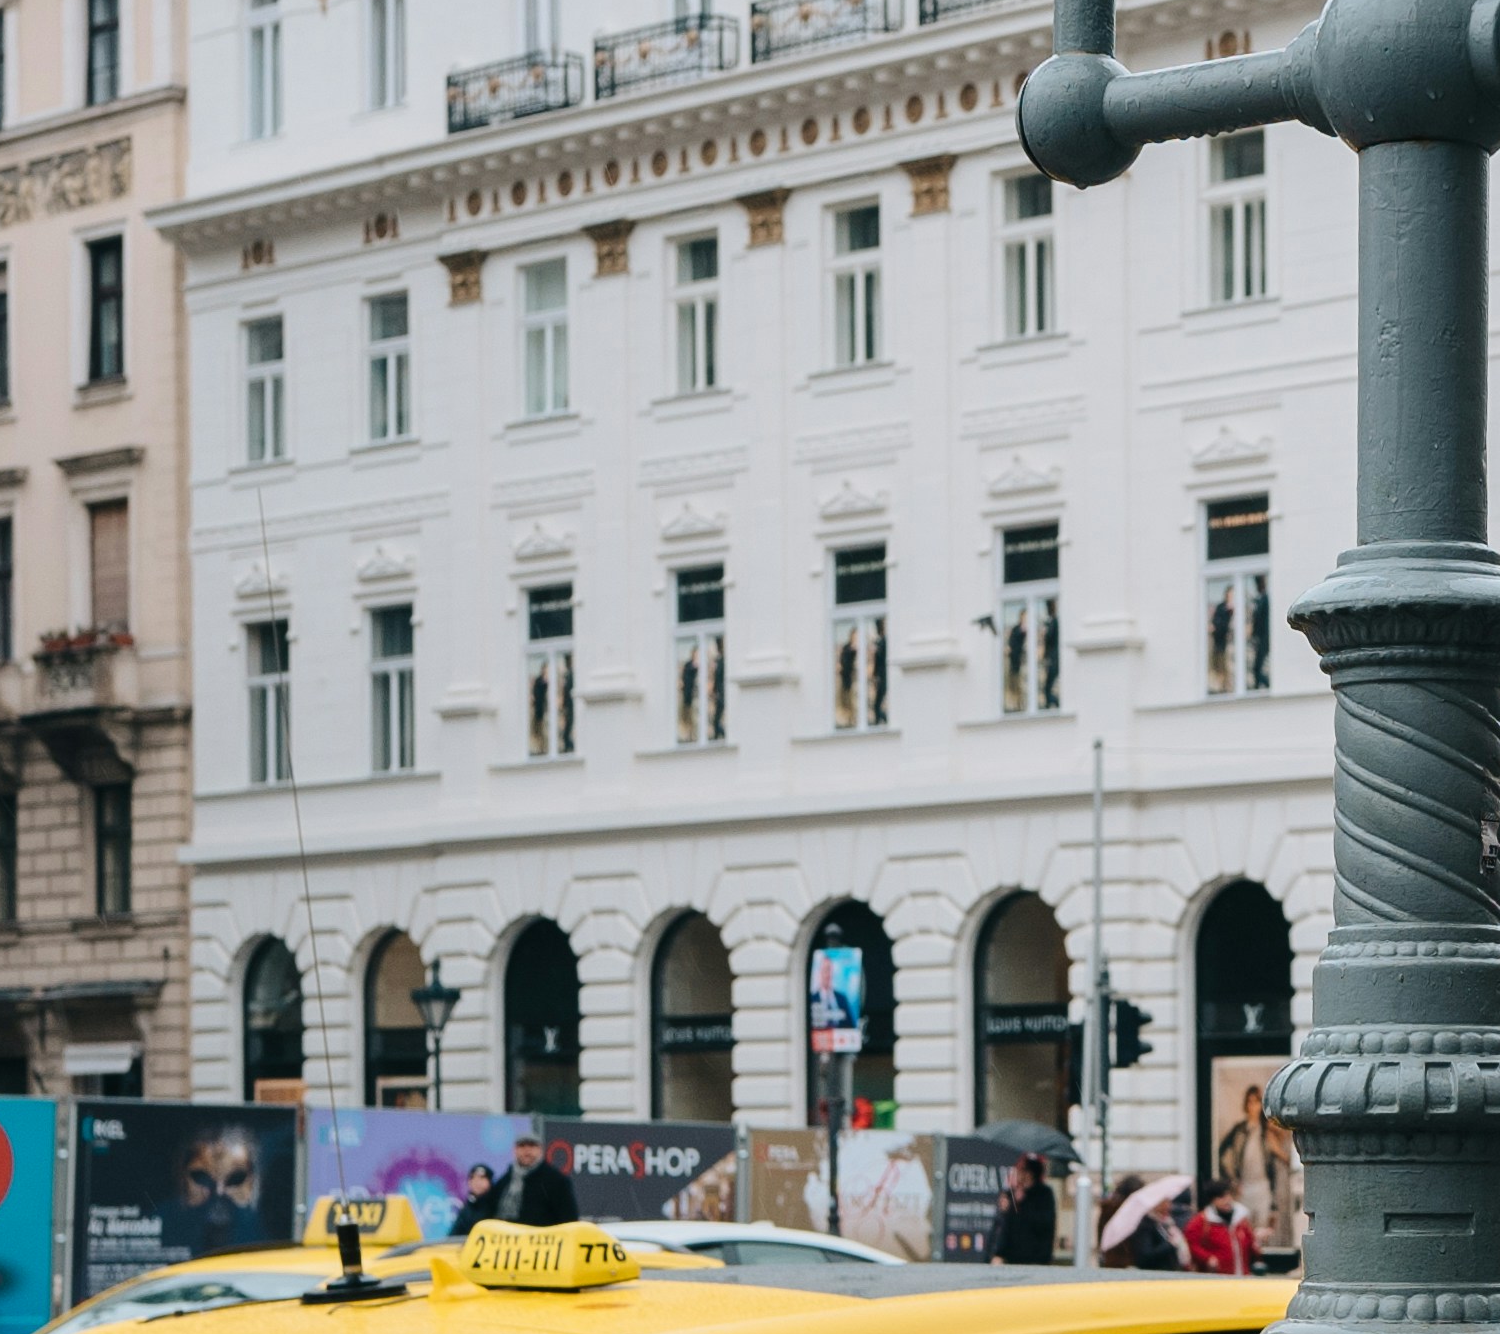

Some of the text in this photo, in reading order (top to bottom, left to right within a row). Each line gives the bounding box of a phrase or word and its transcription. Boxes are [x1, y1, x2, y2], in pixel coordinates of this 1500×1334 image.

[950, 1163, 1000, 1195] OPERA
[471, 1234, 564, 1271] 2-111-111
[490, 1233, 556, 1246] CITY TAXI
[579, 1242, 628, 1264] 776
